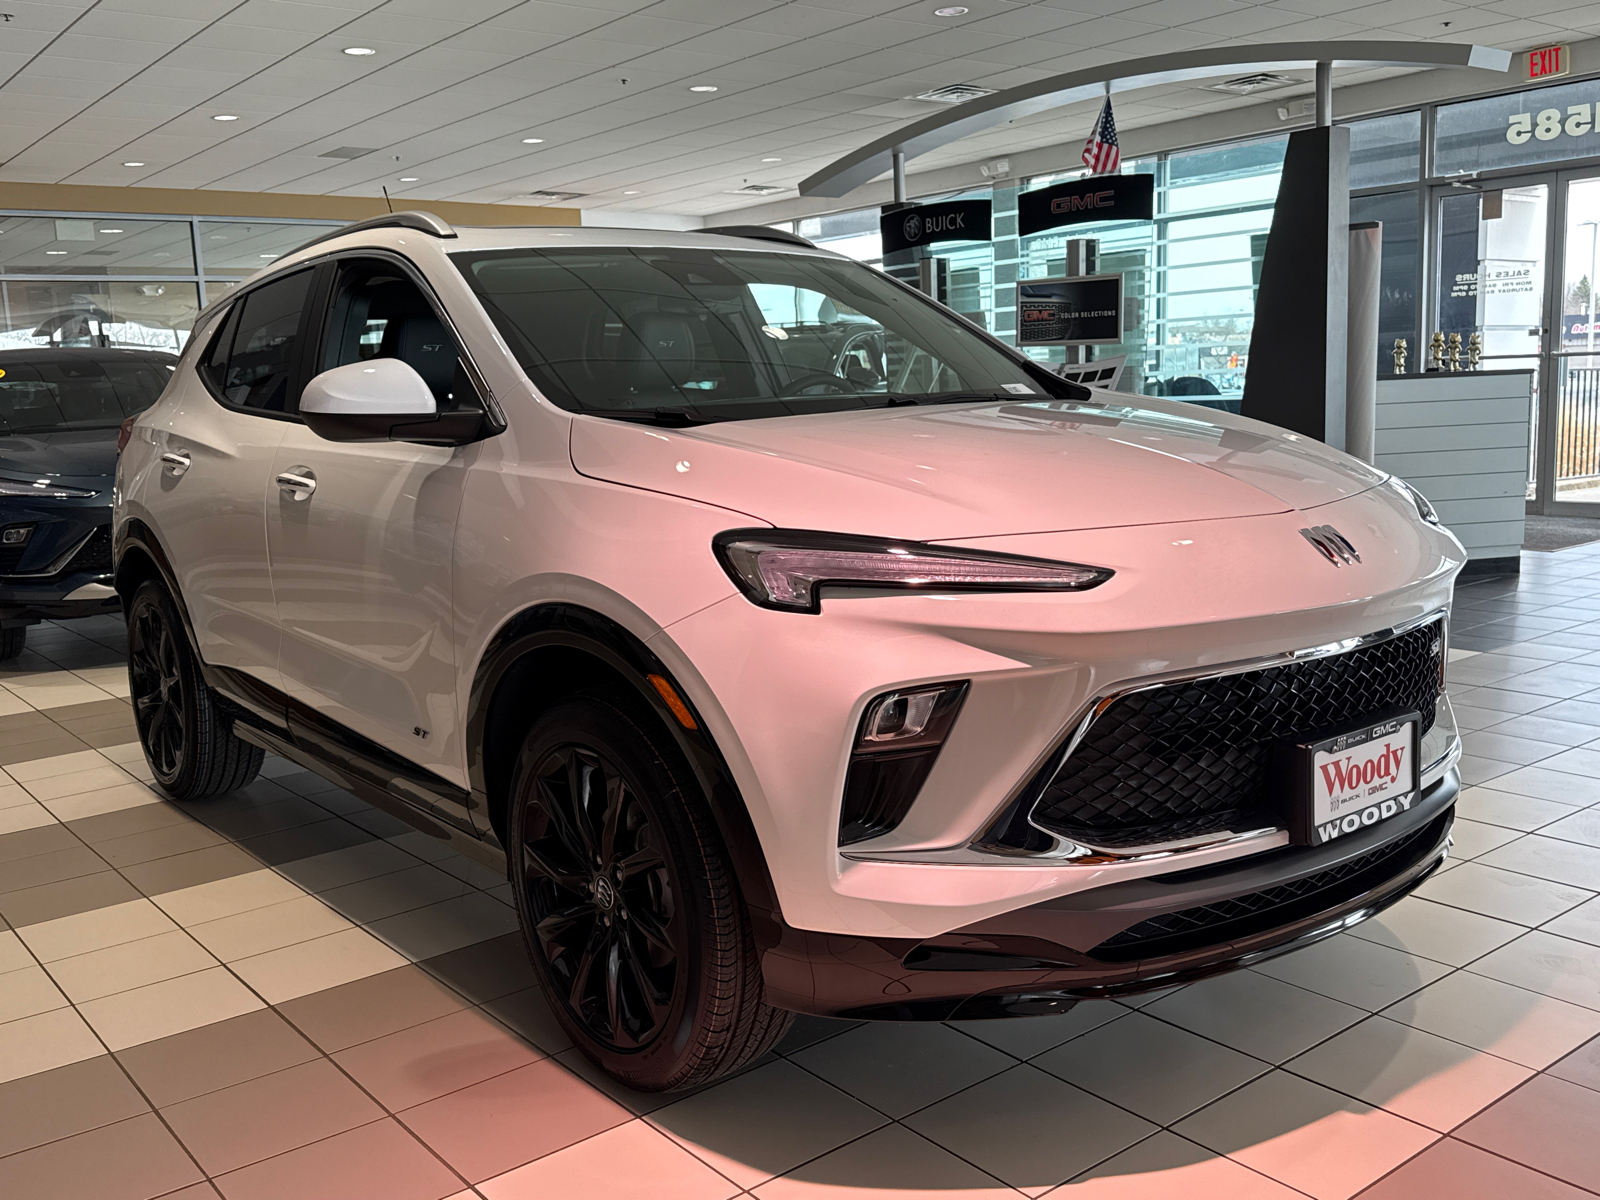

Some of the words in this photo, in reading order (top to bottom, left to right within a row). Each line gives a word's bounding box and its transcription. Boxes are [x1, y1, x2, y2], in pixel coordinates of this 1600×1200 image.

[1530, 46, 1561, 77] EXIT
[1051, 190, 1114, 214] GMC
[925, 212, 965, 233] BUICK
[1024, 310, 1055, 322] GMC
[1061, 311, 1079, 319] COLOR
[1080, 310, 1116, 318] SELECTIONS
[421, 344, 443, 352] ST
[412, 726, 429, 739] ST
[1347, 733, 1367, 744] BUICK
[1372, 721, 1397, 738] GMC
[1319, 743, 1405, 798] Woody
[1341, 793, 1361, 804] BUICK
[1368, 781, 1388, 796] GMC
[1317, 791, 1415, 843] WOODY
